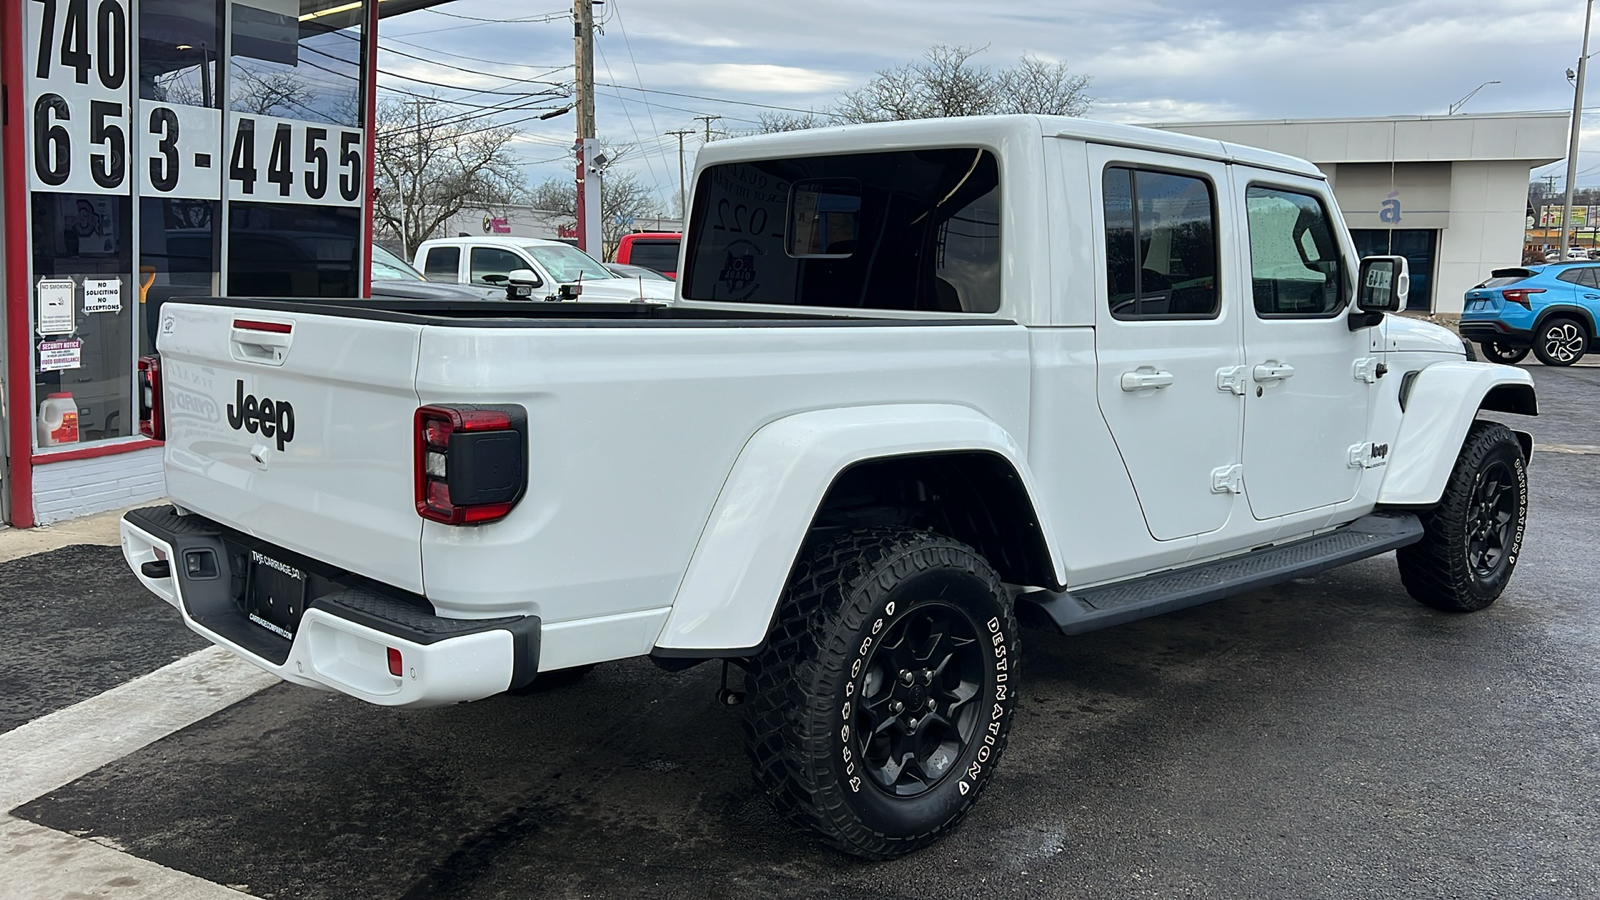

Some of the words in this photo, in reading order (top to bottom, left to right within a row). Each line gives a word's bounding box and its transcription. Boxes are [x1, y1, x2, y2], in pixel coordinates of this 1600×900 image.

[36, 0, 126, 90] 740
[227, 379, 295, 452] Jeep
[968, 616, 1008, 781] DESTINATION
